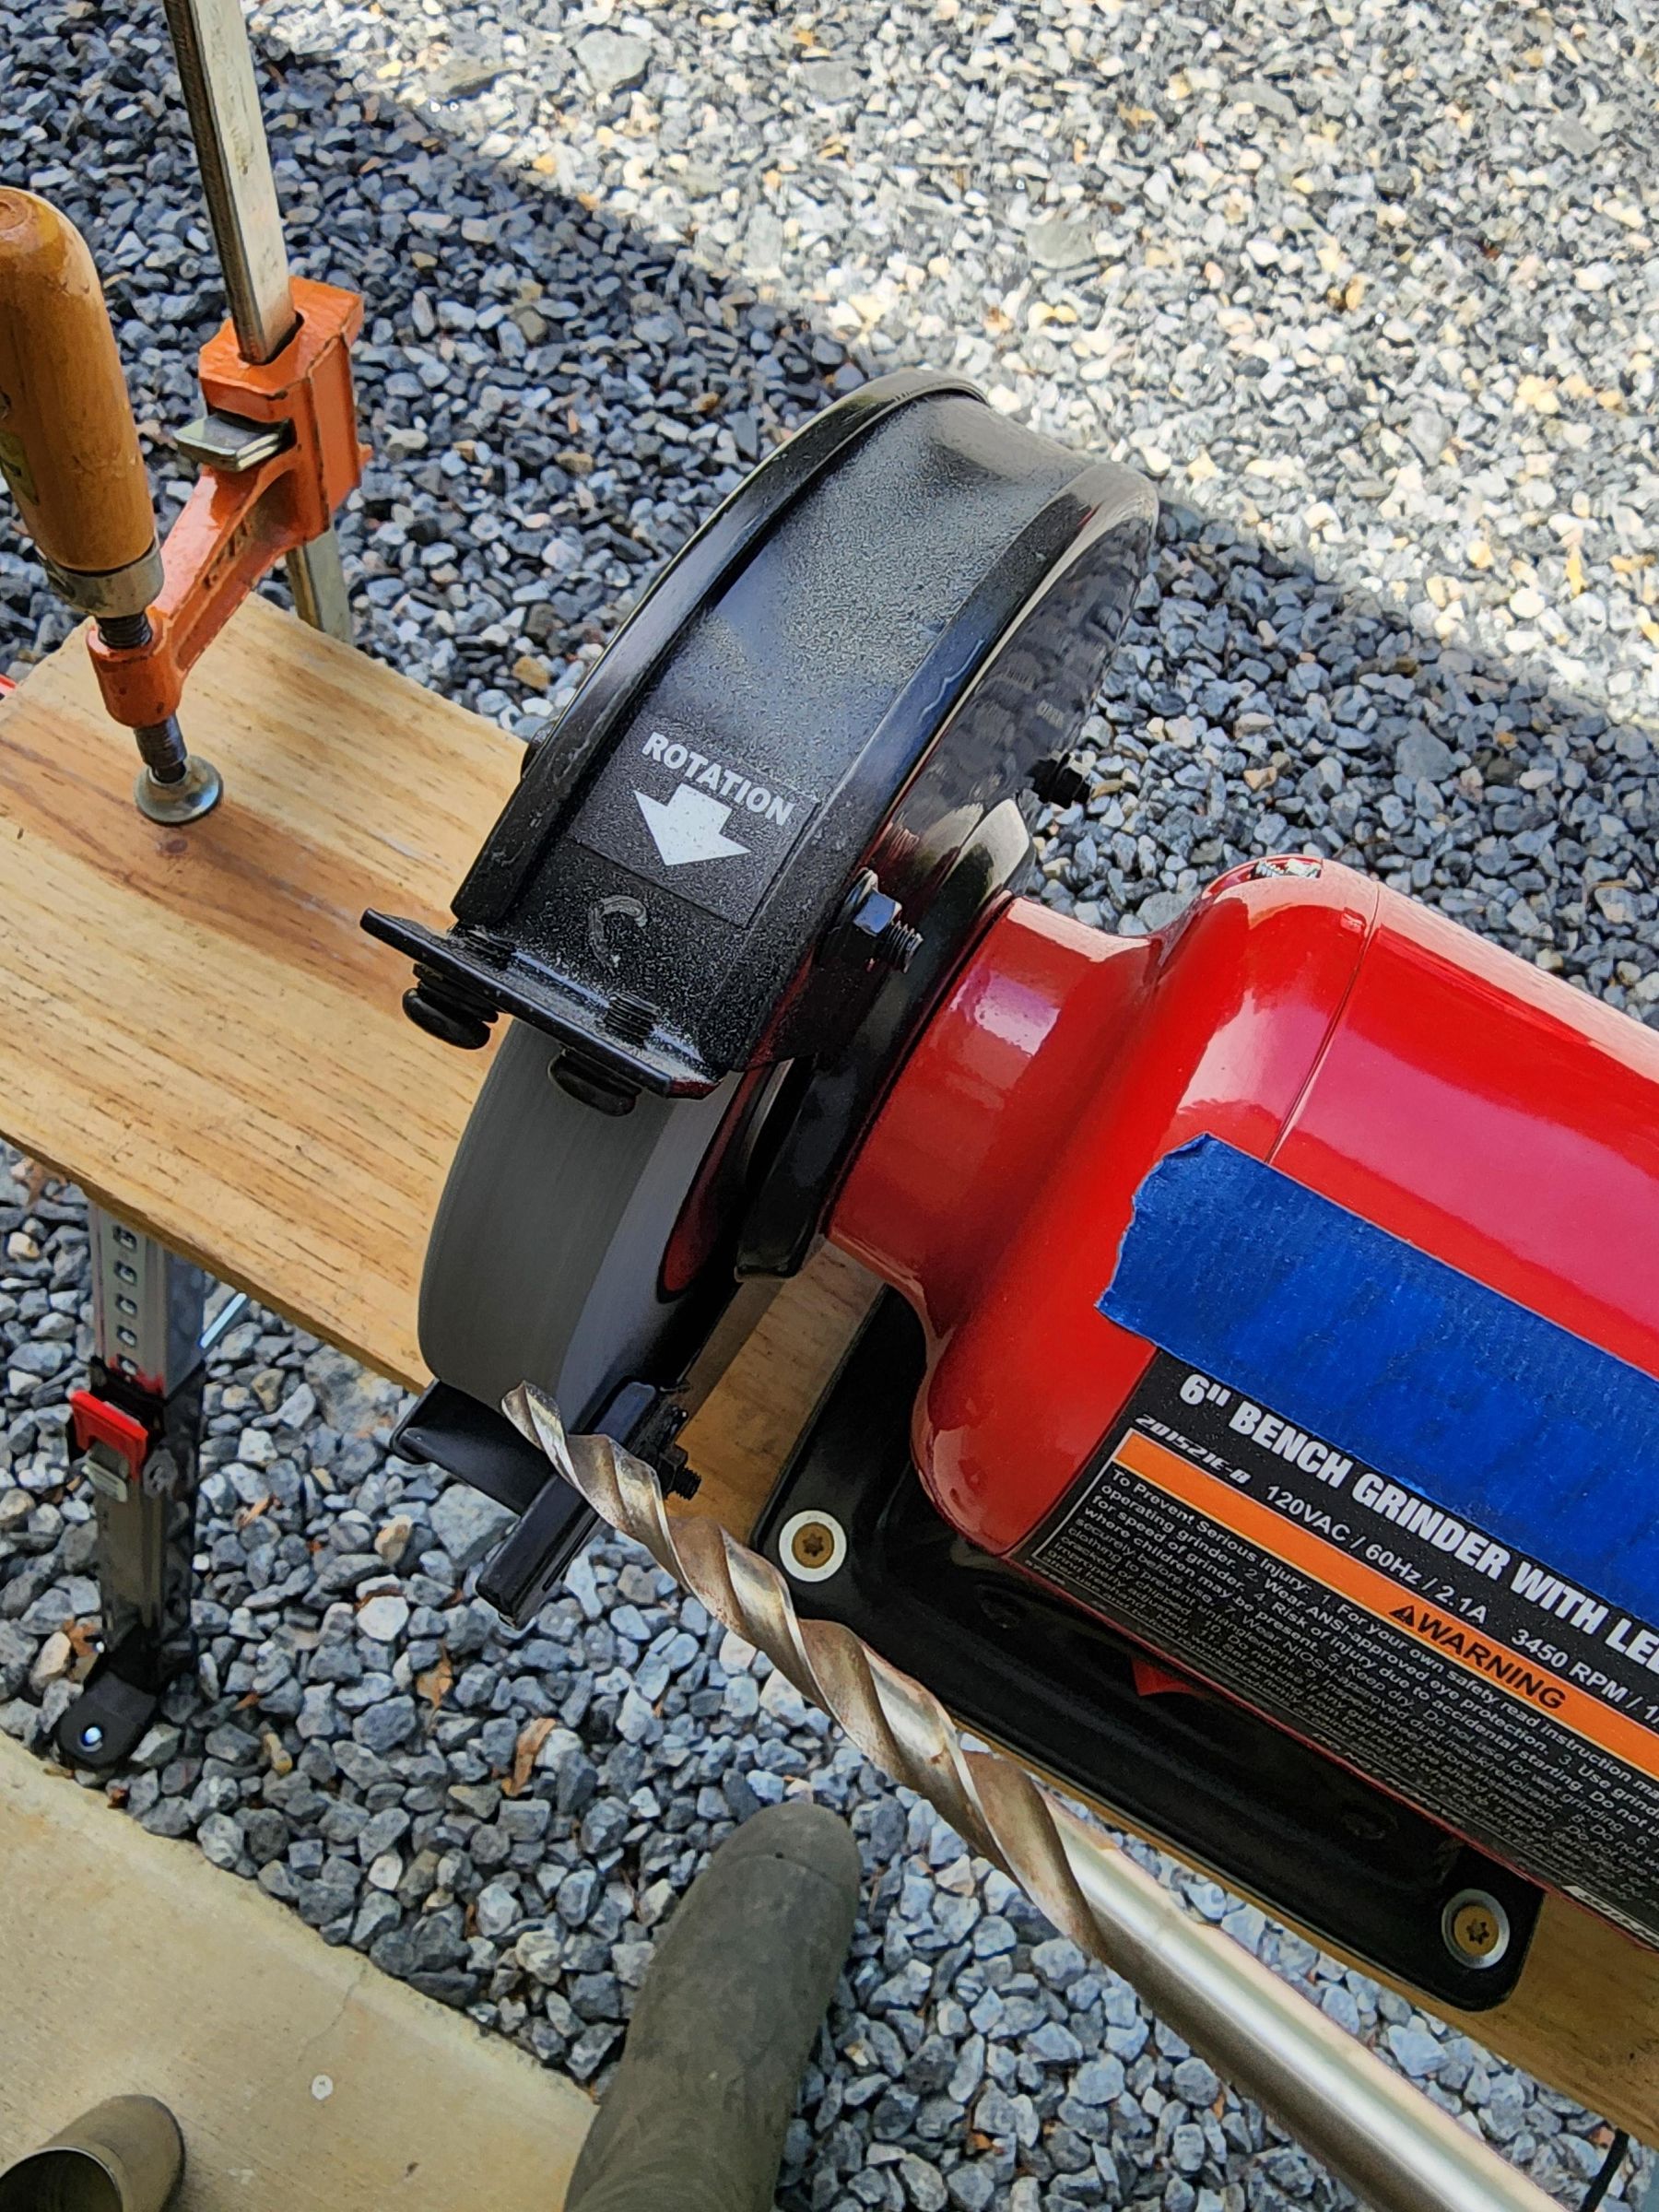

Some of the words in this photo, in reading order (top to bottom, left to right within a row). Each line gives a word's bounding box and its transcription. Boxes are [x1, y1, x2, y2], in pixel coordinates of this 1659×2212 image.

[641, 732, 795, 825] ROTATION
[1092, 1495, 1116, 1512] for
[1117, 1512, 1167, 1543] speed
[1167, 1541, 1188, 1554] of
[1184, 1552, 1245, 1593] grinder.
[1253, 1593, 1266, 1605] 4.
[1271, 1601, 1308, 1629] Risk
[1310, 1627, 1331, 1640] of
[1329, 1636, 1378, 1669] injury
[1378, 1667, 1410, 1688] due
[1412, 1686, 1430, 1700] to
[1431, 1700, 1519, 1751] accidental
[1517, 1750, 1584, 1794] starting.
[1588, 1790, 1615, 1808] Do
[1616, 1808, 1648, 1828] not
[1100, 1485, 1175, 1534] operating
[1176, 1529, 1236, 1570] grinder.
[1264, 1578, 1307, 1607] Wear
[1305, 1606, 1430, 1681] ANSI-approved
[1430, 1679, 1460, 1700] eye
[1459, 1698, 1549, 1755] protection.
[1558, 1754, 1572, 1769] 3.
[1578, 1763, 1611, 1789] Use
[1112, 1468, 1131, 1487] To
[1133, 1482, 1195, 1525] Prevent
[1196, 1520, 1257, 1562] Serious
[1259, 1558, 1312, 1594] Injury:
[1336, 1604, 1368, 1626] For
[1365, 1623, 1408, 1650] your
[1409, 1649, 1444, 1673] own
[1446, 1670, 1500, 1704] safety
[1500, 1701, 1542, 1727] read
[1540, 1723, 1632, 1783] instruction
[1180, 1373, 1231, 1407] 6"
[1229, 1400, 1354, 1488] BENCH
[1352, 1473, 1511, 1581] GRINDER
[1510, 1560, 1609, 1635] WITH
[1266, 1486, 1350, 1541] 120VAC
[1349, 1535, 1367, 1549] /
[1365, 1544, 1422, 1585] 60Hz
[1421, 1577, 1439, 1591] /
[1434, 1585, 1487, 1624] 2.1A
[1511, 1629, 1569, 1668] 3450
[1569, 1661, 1629, 1702] RPM
[1625, 1692, 1643, 1710] /
[1417, 1612, 1566, 1710] WARNING
[1060, 1535, 1116, 1571] cracked
[1117, 1570, 1135, 1581] or
[1227, 1634, 1249, 1651] Do
[1251, 1650, 1277, 1666] not
[1277, 1665, 1304, 1684] use
[1306, 1683, 1319, 1691] if
[1317, 1691, 1347, 1709] any
[1347, 1709, 1394, 1736] guard
[1393, 1735, 1412, 1746] or
[1411, 1746, 1440, 1765] eye
[1441, 1764, 1488, 1793] shield
[1628, 1877, 1649, 1888] or
[1067, 1527, 1125, 1563] clothing
[1124, 1559, 1140, 1572] to
[1139, 1569, 1196, 1606] prevent
[1322, 1679, 1378, 1715] Inspect
[1378, 1713, 1424, 1742] wheel
[1422, 1740, 1473, 1772] before
[1562, 1825, 1590, 1841] Do
[1590, 1841, 1619, 1860] not
[1618, 1857, 1648, 1876] use
[1075, 1518, 1136, 1556] securely
[1136, 1552, 1183, 1584] before
[1242, 1615, 1282, 1642] Wear
[1282, 1640, 1410, 1720] NIOSH-approved
[1409, 1718, 1445, 1742] dust
[1589, 1823, 1615, 1841] Do
[1615, 1841, 1644, 1858] not
[1085, 1507, 1131, 1538] where
[1133, 1537, 1195, 1578] children
[1197, 1575, 1233, 1598] may
[1232, 1595, 1254, 1612] be
[1254, 1611, 1319, 1653] present.
[1345, 1663, 1386, 1691] Keep
[1388, 1690, 1415, 1710] dry.
[1422, 1709, 1447, 1727] Do
[1448, 1724, 1476, 1743] not
[1475, 1741, 1505, 1761] use
[1507, 1759, 1532, 1775] for
[1531, 1773, 1562, 1794] wet
[1559, 1793, 1626, 1835] grinding.
